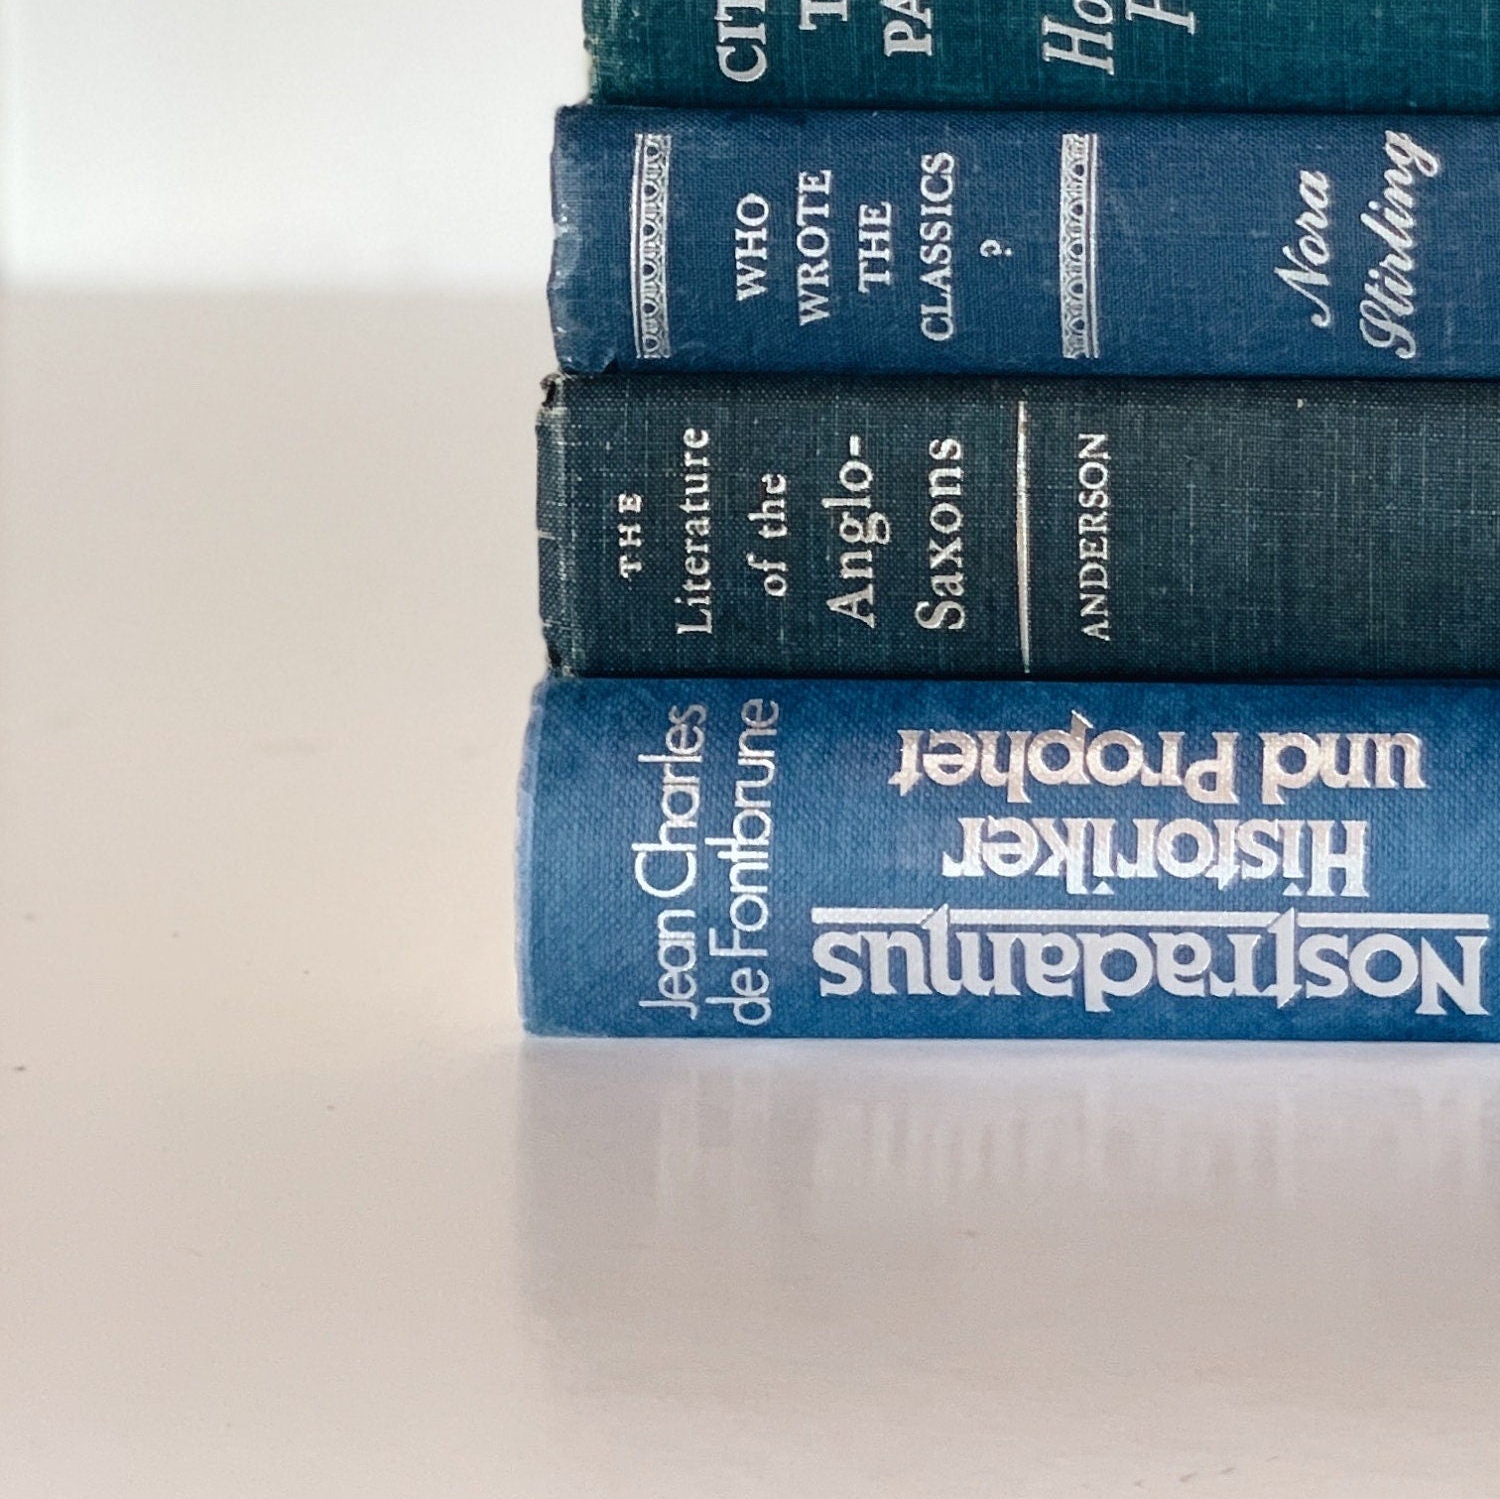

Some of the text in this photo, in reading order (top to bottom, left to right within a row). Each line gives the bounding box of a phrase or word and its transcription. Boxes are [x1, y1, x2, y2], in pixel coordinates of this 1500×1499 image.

[735, 193, 769, 301] WHO
[797, 169, 832, 326] WROTE
[859, 201, 891, 293] THE
[920, 152, 955, 342] CLASSICS
[979, 238, 1012, 258] ?
[1273, 170, 1331, 327] Nora
[1359, 130, 1440, 359] Stirling
[618, 493, 642, 580] THE
[676, 427, 713, 635] Literature
[747, 473, 787, 597] of the
[822, 433, 890, 628] Anglo-
[916, 438, 964, 630] Saxons
[1078, 433, 1111, 641] ANDERSON
[888, 709, 1427, 804] und Prophet
[631, 703, 707, 1020] Jean Charles
[704, 698, 779, 1026] de Fontbrune
[942, 814, 1369, 897] Historiker
[811, 903, 1490, 1016] Nostradamus
